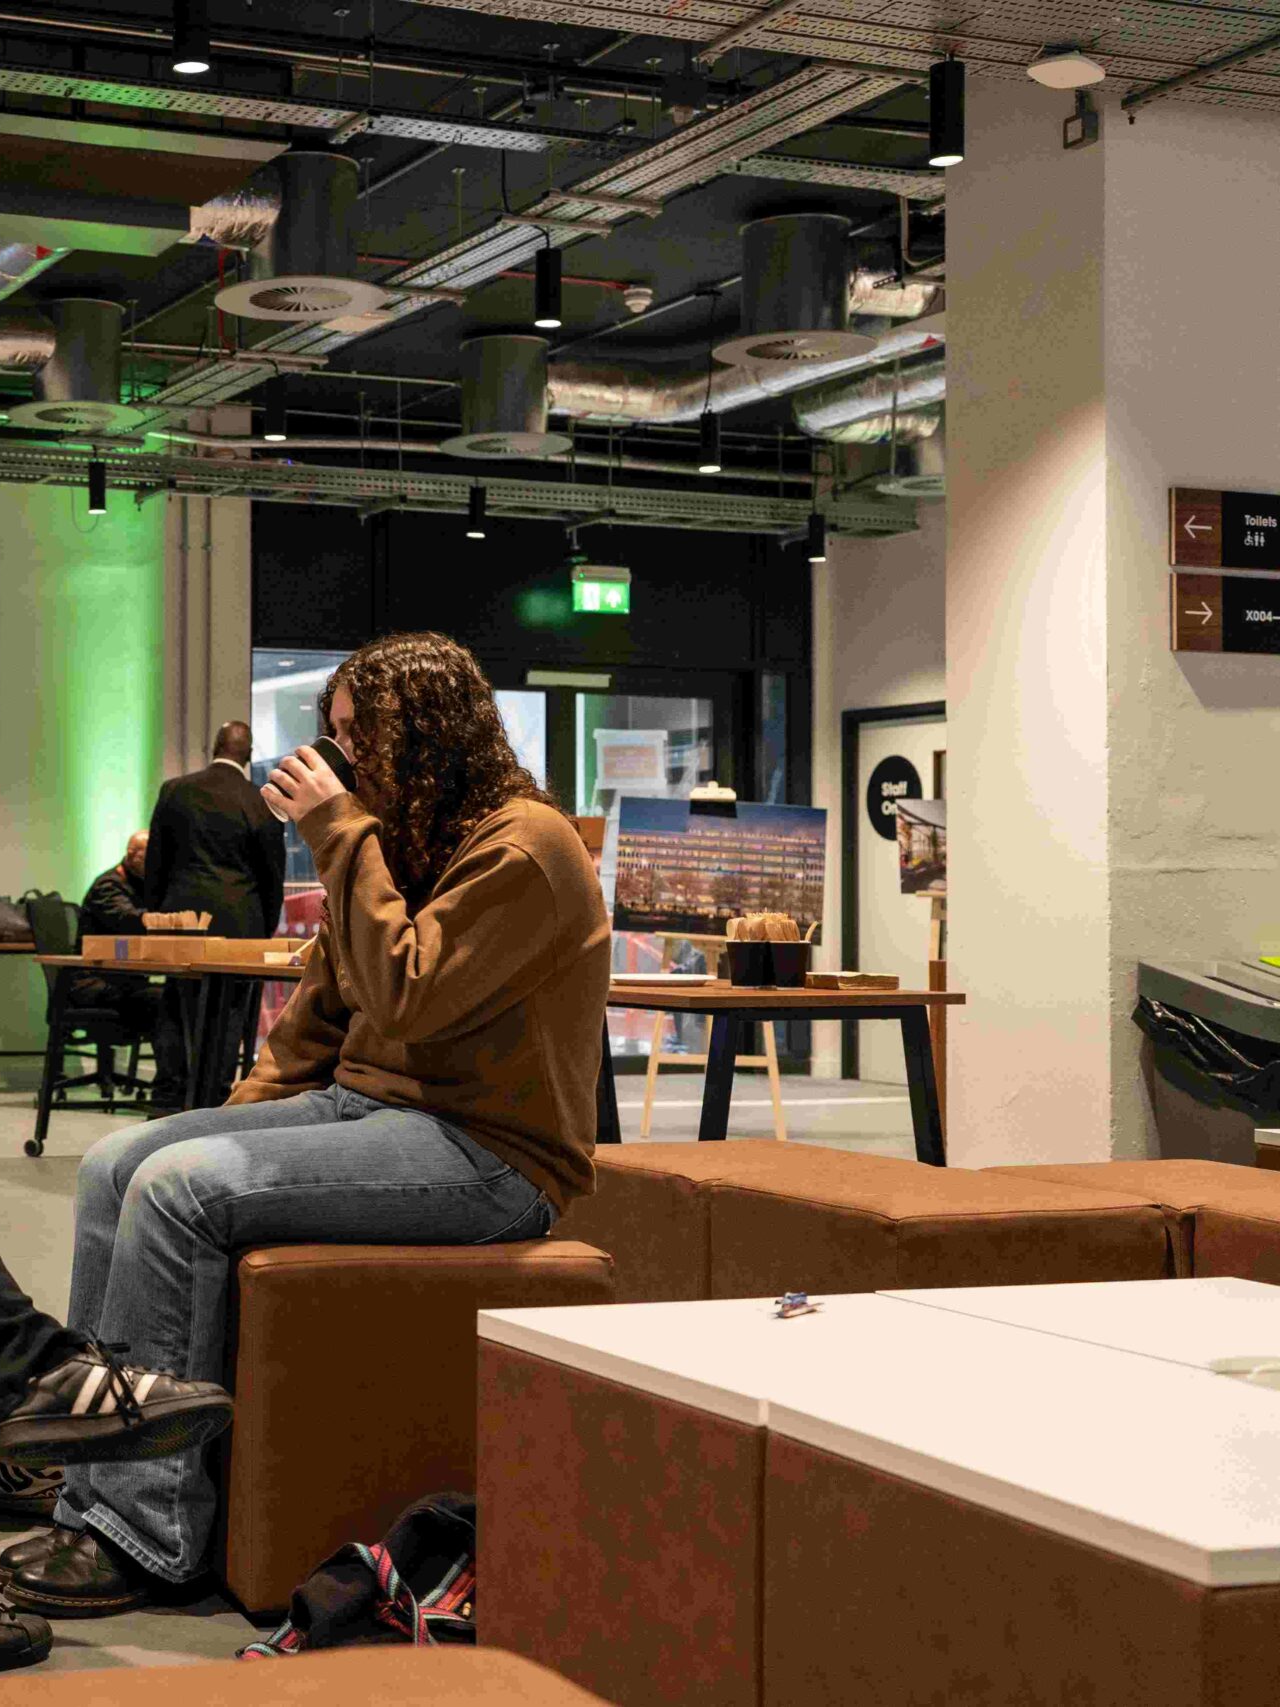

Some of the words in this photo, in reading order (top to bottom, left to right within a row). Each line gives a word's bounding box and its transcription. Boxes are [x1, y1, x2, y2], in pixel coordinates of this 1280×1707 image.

[1244, 514, 1278, 528] Toilets
[881, 781, 908, 797] Staff
[881, 800, 897, 816] On
